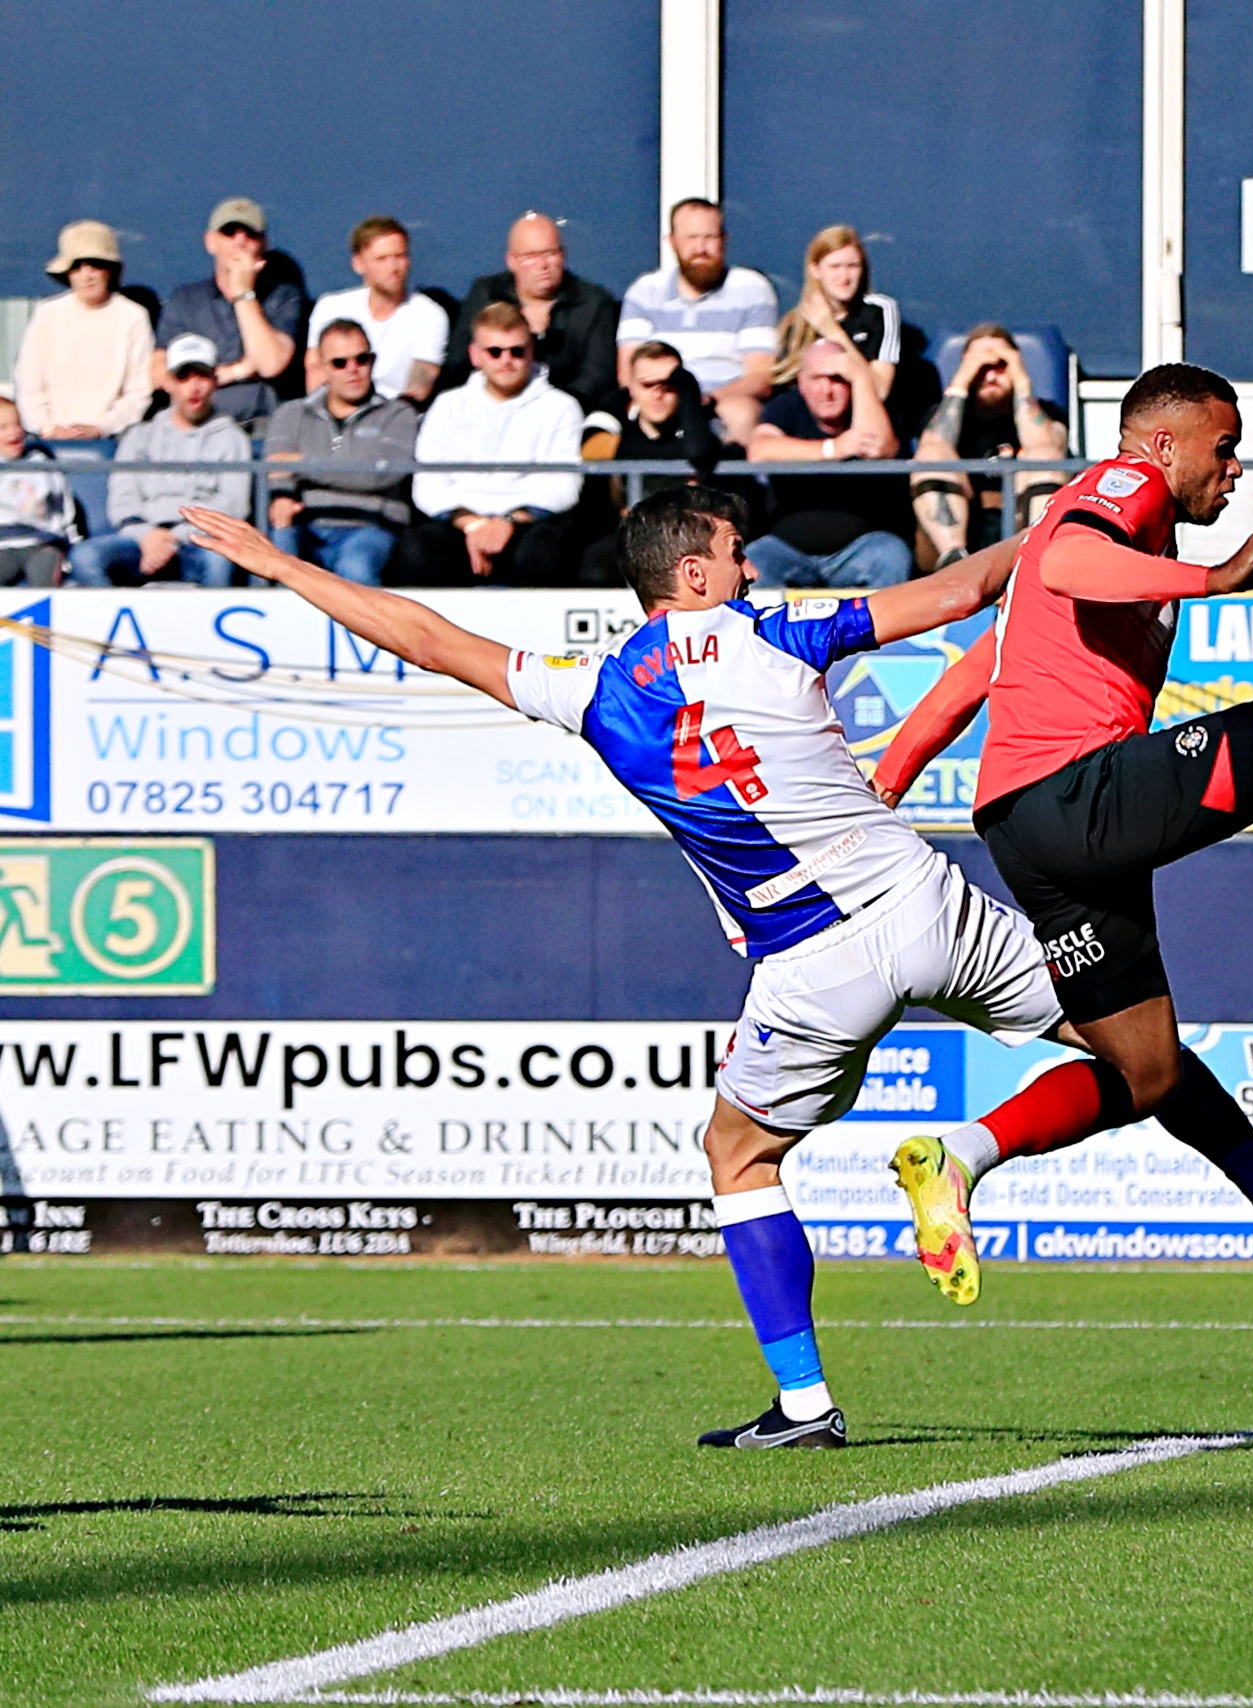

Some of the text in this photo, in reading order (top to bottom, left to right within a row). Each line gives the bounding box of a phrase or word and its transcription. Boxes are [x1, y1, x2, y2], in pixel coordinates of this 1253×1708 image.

[632, 634, 720, 688] AYALA
[87, 711, 405, 762] Windows
[672, 700, 769, 805] 4
[495, 758, 580, 785] SCAN
[896, 757, 981, 804] ETS
[87, 779, 405, 813] 07825 304717
[511, 793, 557, 819] ON
[104, 879, 159, 957] 5
[0, 1030, 717, 1110] w.LFWpubs.co.u
[867, 1046, 931, 1075] ance
[853, 1075, 938, 1112] ilable
[12, 1117, 125, 1154] AGE
[148, 1117, 355, 1154] EATING
[377, 1118, 414, 1154] &
[796, 1152, 898, 1174] Manufact
[1124, 1182, 1244, 1207] Conservato
